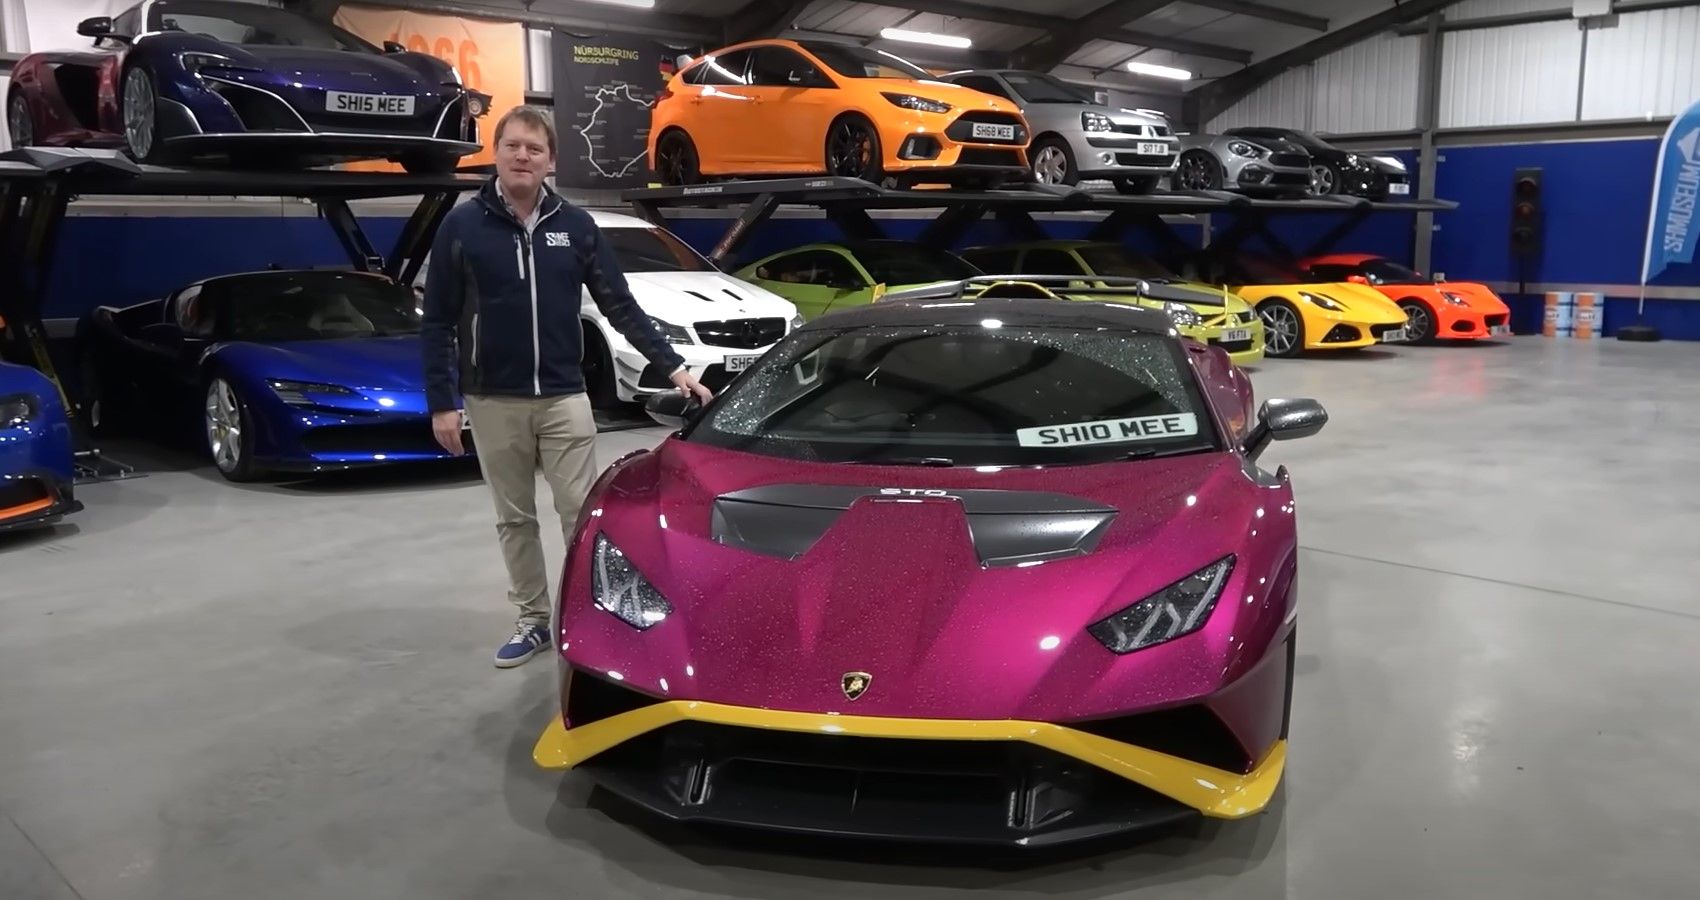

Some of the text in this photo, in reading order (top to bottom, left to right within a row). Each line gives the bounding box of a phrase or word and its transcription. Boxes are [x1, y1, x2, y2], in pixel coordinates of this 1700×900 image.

[573, 45, 639, 60] NÜRBURGRING
[378, 97, 407, 112] MEE
[997, 126, 1012, 138] MEE
[1118, 417, 1185, 437] MEE
[880, 488, 947, 496] STO
